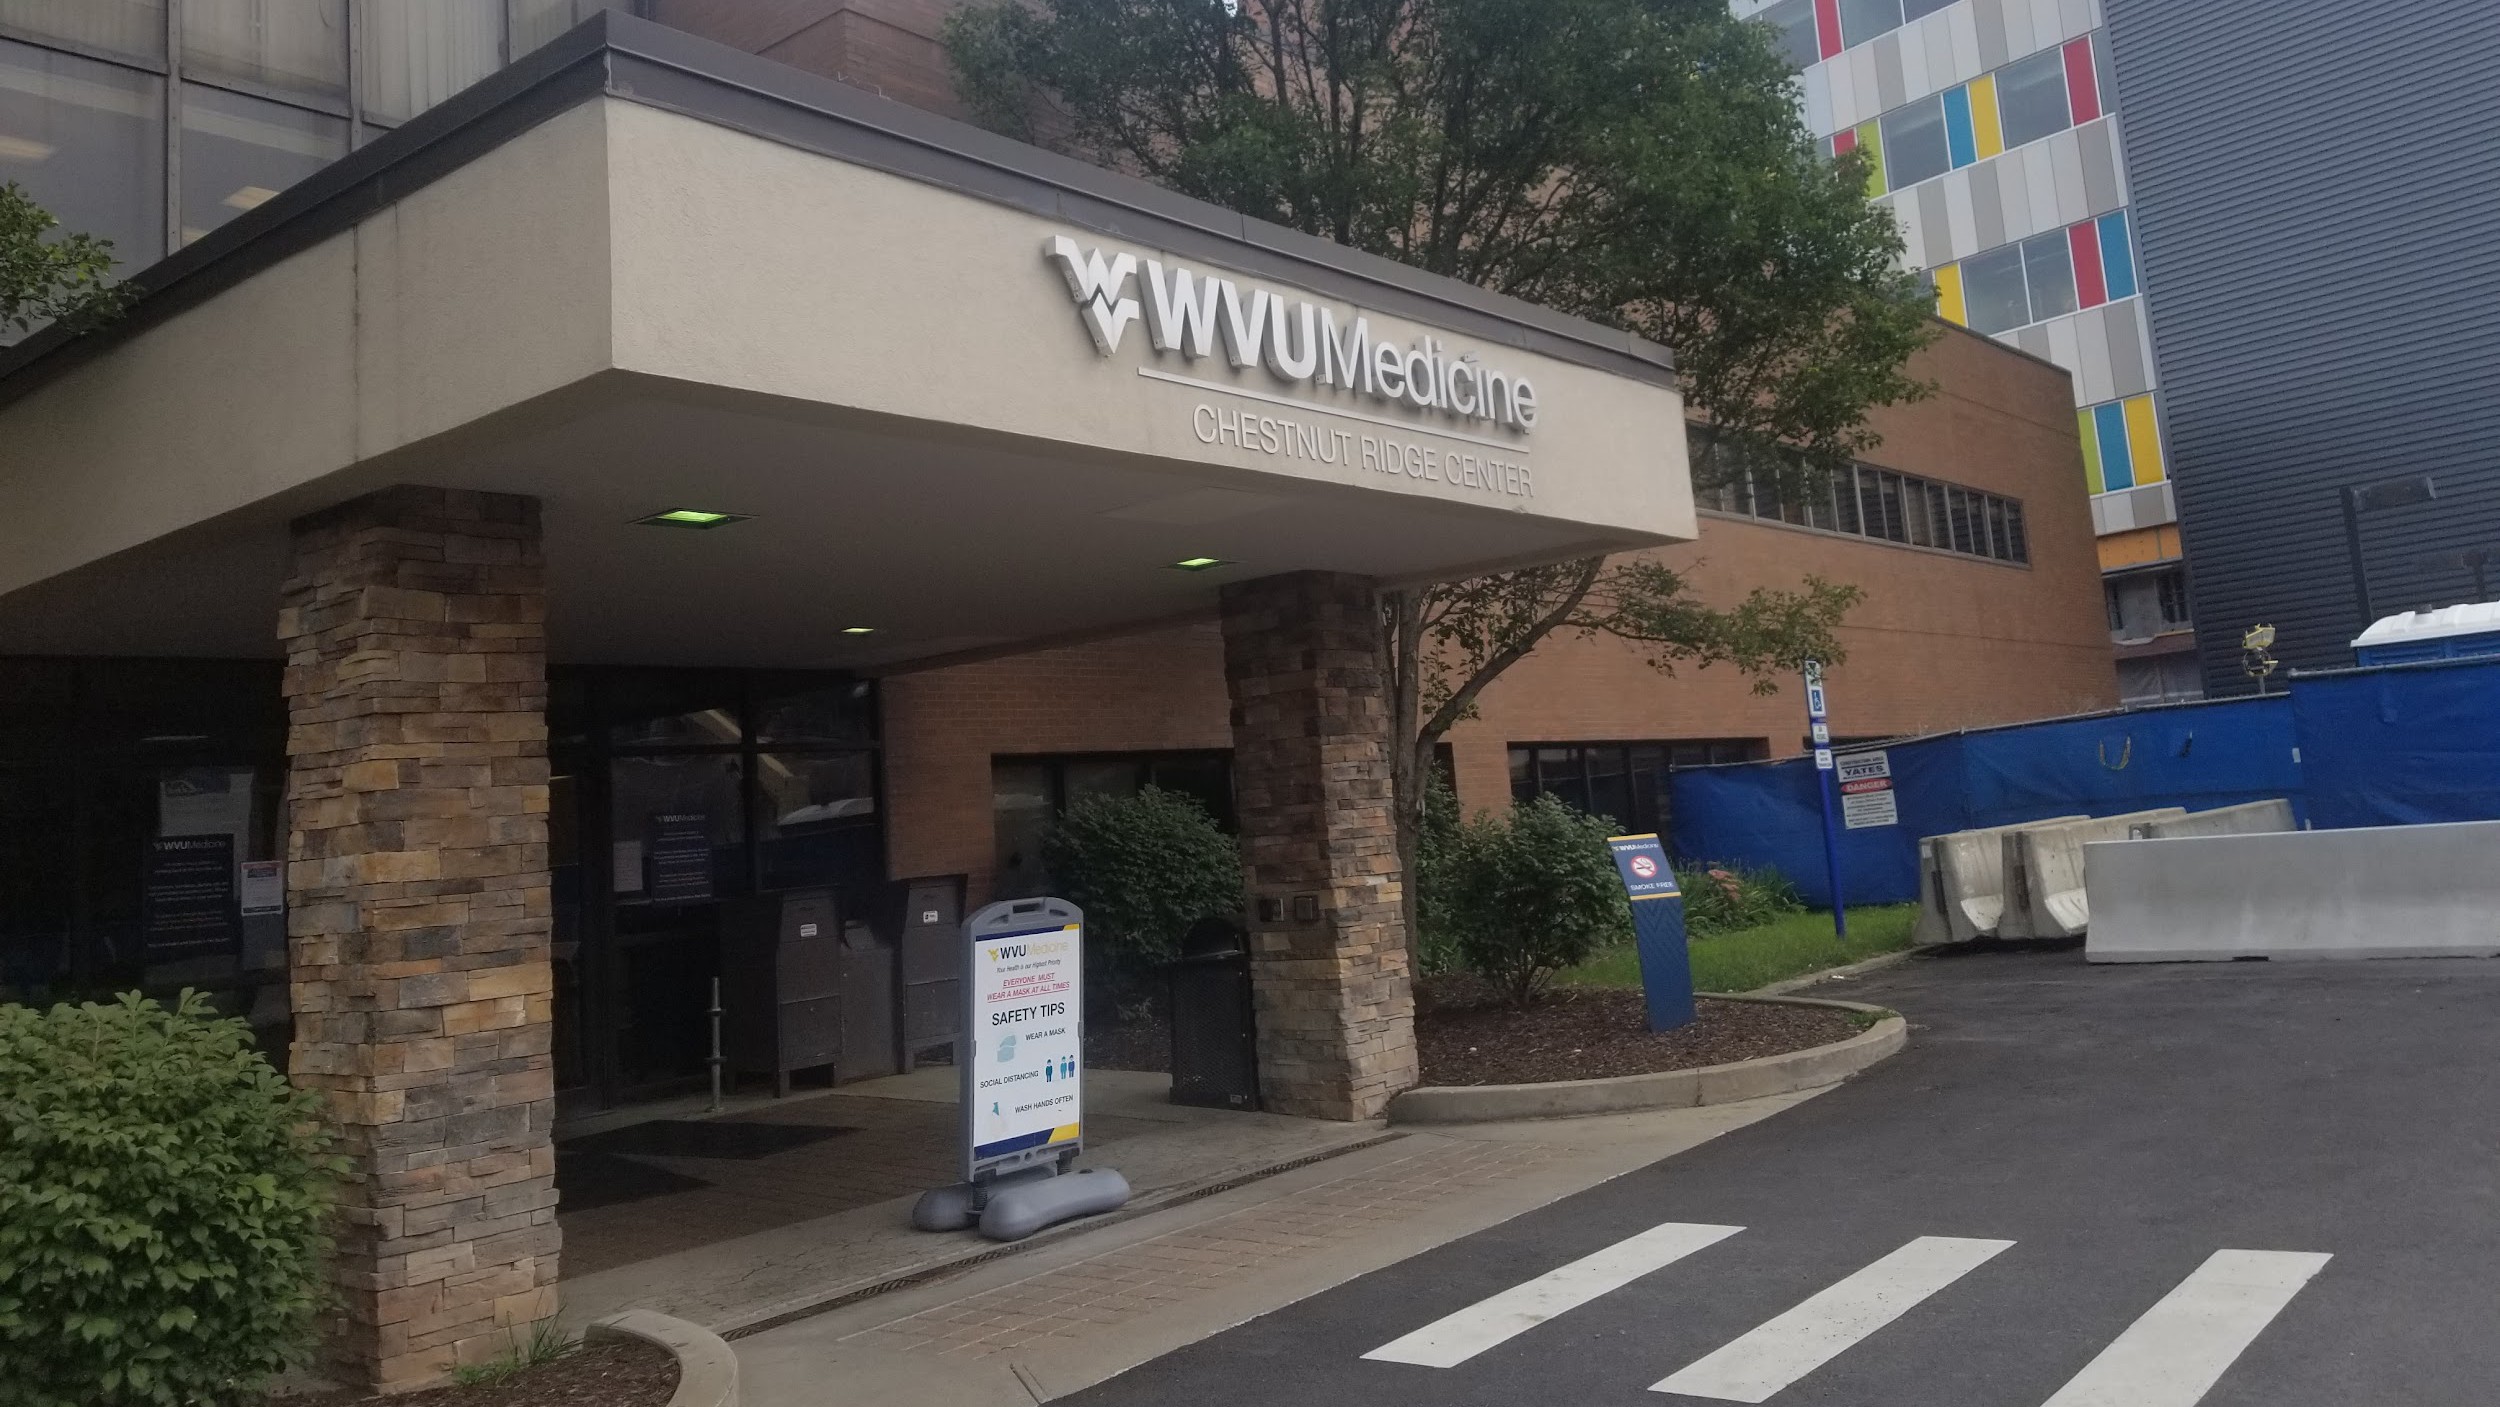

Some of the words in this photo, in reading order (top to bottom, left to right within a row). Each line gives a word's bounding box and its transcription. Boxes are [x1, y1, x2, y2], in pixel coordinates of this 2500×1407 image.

[1193, 404, 1352, 466] CHESTNUT
[1360, 434, 1439, 482] RIDGE
[1444, 453, 1534, 498] CENTER
[1844, 765, 1884, 776] YATES
[1846, 780, 1888, 792] DANGER
[1630, 883, 1656, 891] SMOKE
[1006, 964, 1020, 972] Health
[1032, 961, 1047, 969] Highest
[1047, 959, 1061, 967] Priority
[1003, 975, 1036, 987] EVERYONE
[1038, 972, 1055, 982] MUST
[987, 990, 1006, 1001] WEAR
[1006, 990, 1012, 998] A
[1012, 987, 1030, 997] MASK
[1031, 985, 1040, 994] AT
[1040, 983, 1051, 992] ALL
[1052, 981, 1070, 990] TIMES
[992, 1006, 1037, 1026] SAFETY
[1040, 1002, 1065, 1018] TIPS
[1025, 1031, 1043, 1041] WEAR
[1049, 1027, 1066, 1036] MASK
[980, 1078, 1002, 1089] SOCIAL
[1003, 1070, 1039, 1084] DISTANCING
[1015, 1104, 1032, 1114] WASH
[1033, 1098, 1054, 1109] HANDS
[1054, 1094, 1074, 1105] OFTEN
